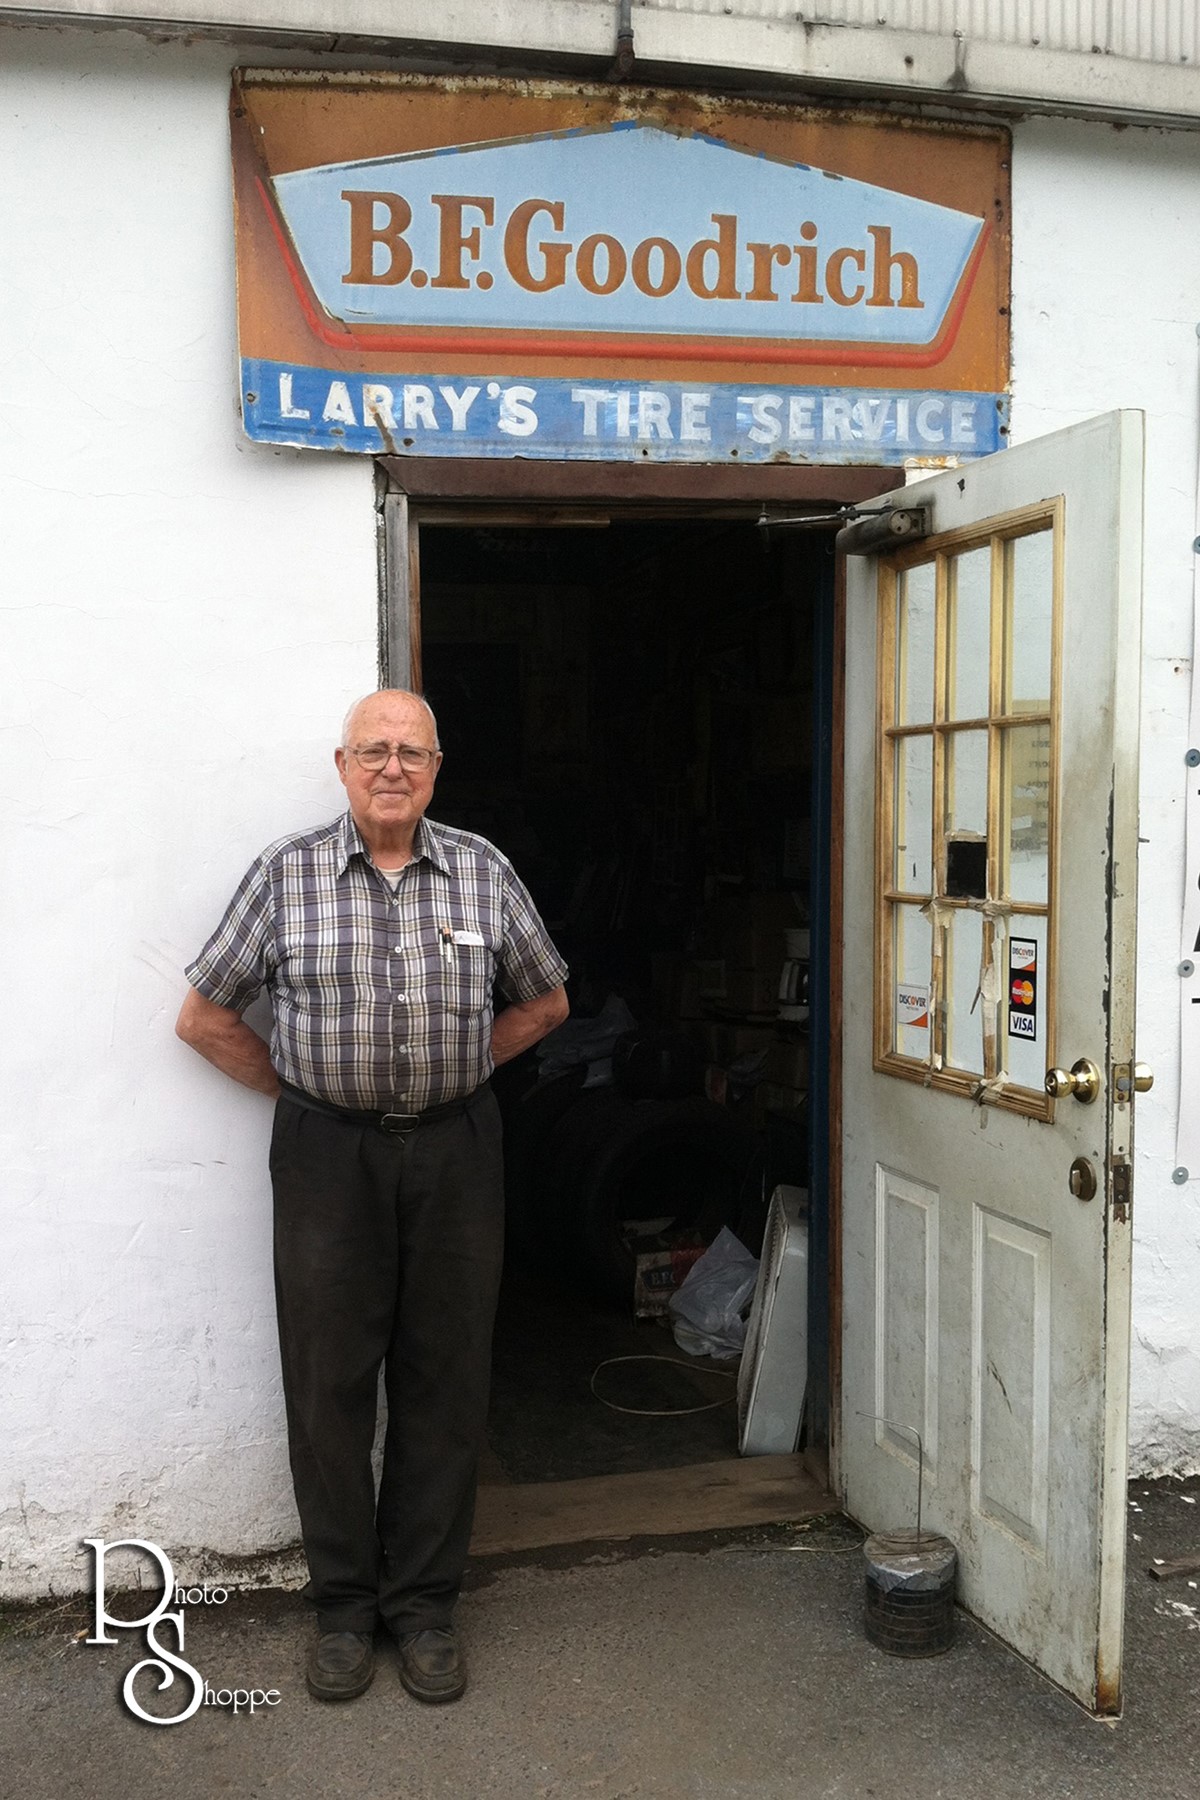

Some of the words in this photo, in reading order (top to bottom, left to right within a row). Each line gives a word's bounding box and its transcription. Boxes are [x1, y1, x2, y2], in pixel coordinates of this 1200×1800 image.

[279, 372, 538, 436] LARRY'S
[571, 389, 711, 441] TIRE
[747, 394, 977, 444] SERVICE
[899, 993, 926, 1007] DISCOVER
[1012, 1016, 1033, 1032] VISA
